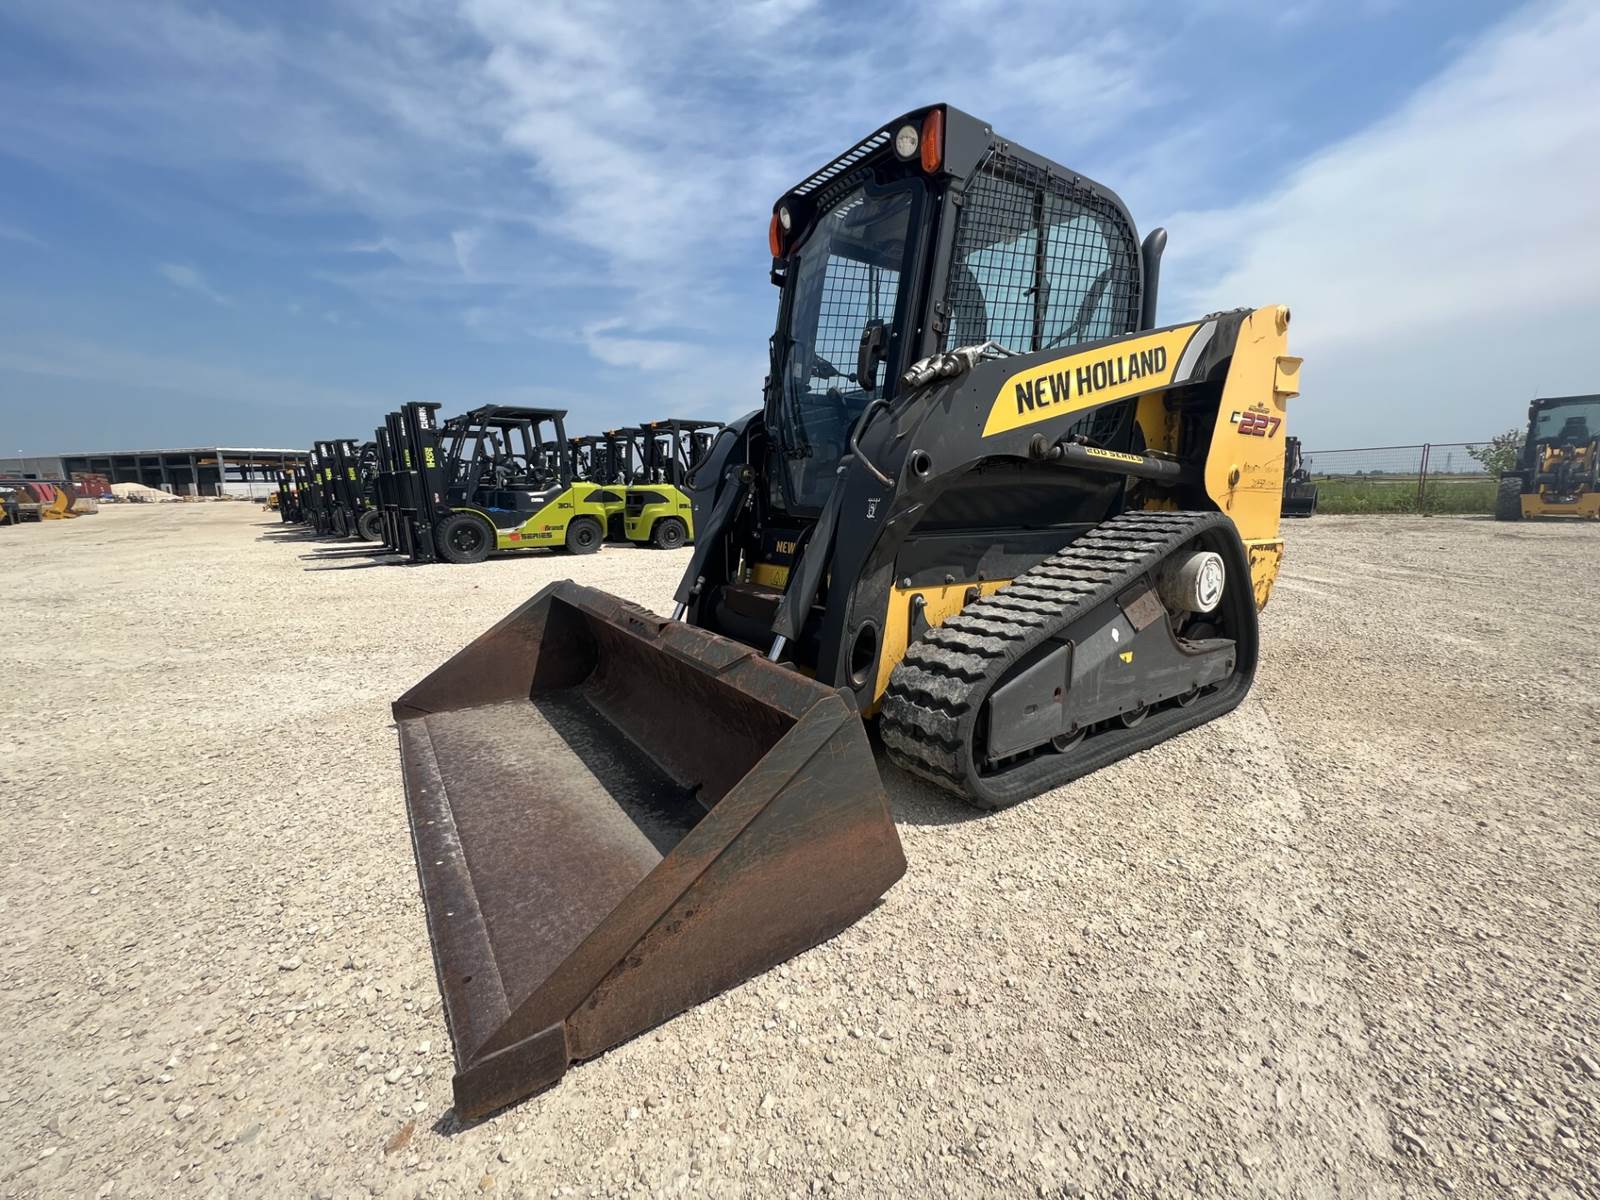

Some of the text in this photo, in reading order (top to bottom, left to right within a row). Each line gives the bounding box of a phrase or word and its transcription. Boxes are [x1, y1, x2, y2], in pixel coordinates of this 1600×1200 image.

[1015, 346, 1167, 414] NEW HOLLAND
[776, 541, 796, 554] NEW
